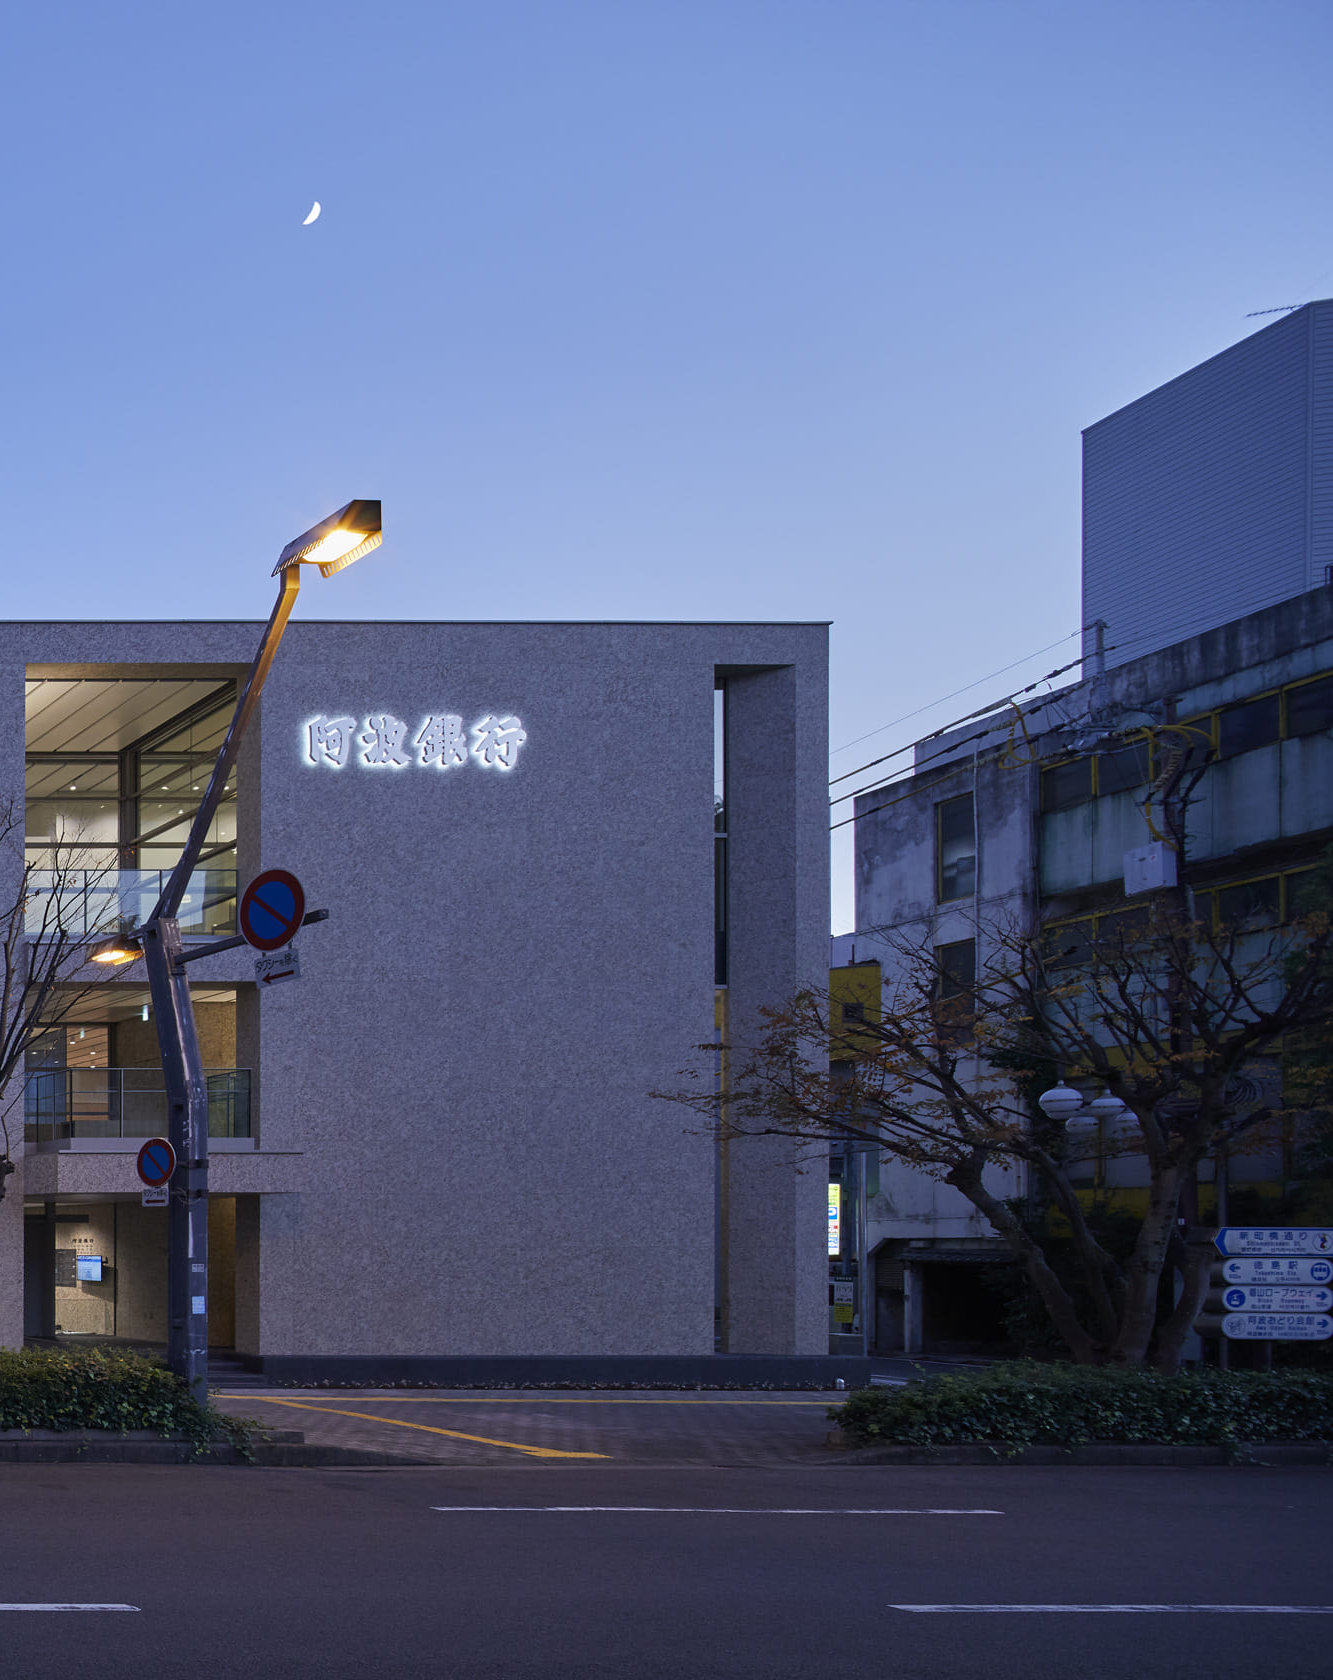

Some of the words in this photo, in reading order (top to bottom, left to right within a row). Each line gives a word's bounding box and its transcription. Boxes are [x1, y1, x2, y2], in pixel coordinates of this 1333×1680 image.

[307, 714, 527, 767] 阿波銀行
[256, 952, 299, 974] タクシーを除く
[1240, 1232, 1308, 1240] 新町橋通り
[1254, 1261, 1298, 1270] 徳島駅
[1250, 1288, 1314, 1297] 眉山ロープウェイ
[1248, 1316, 1315, 1325] 阿波おどり会館
